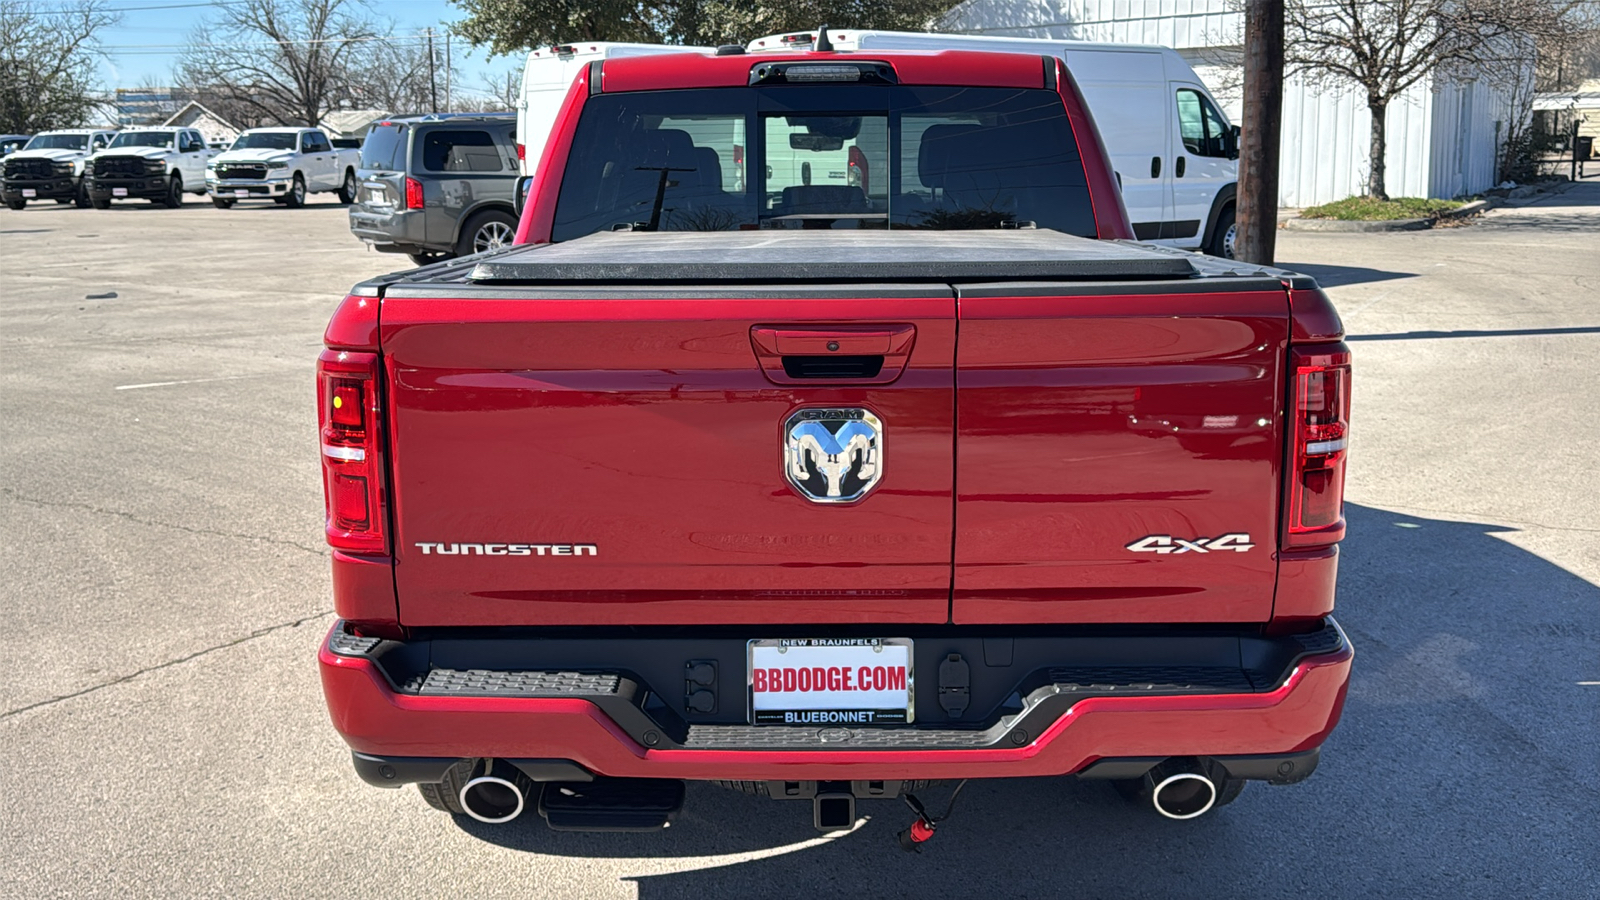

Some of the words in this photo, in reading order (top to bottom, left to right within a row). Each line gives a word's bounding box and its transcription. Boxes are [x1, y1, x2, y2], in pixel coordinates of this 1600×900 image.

[803, 409, 864, 420] RAM
[414, 542, 598, 556] TUNGSTEN
[1125, 533, 1255, 554] 4x4
[753, 666, 906, 692] BBDODGE.COM
[785, 711, 875, 723] BLUEBONNET
